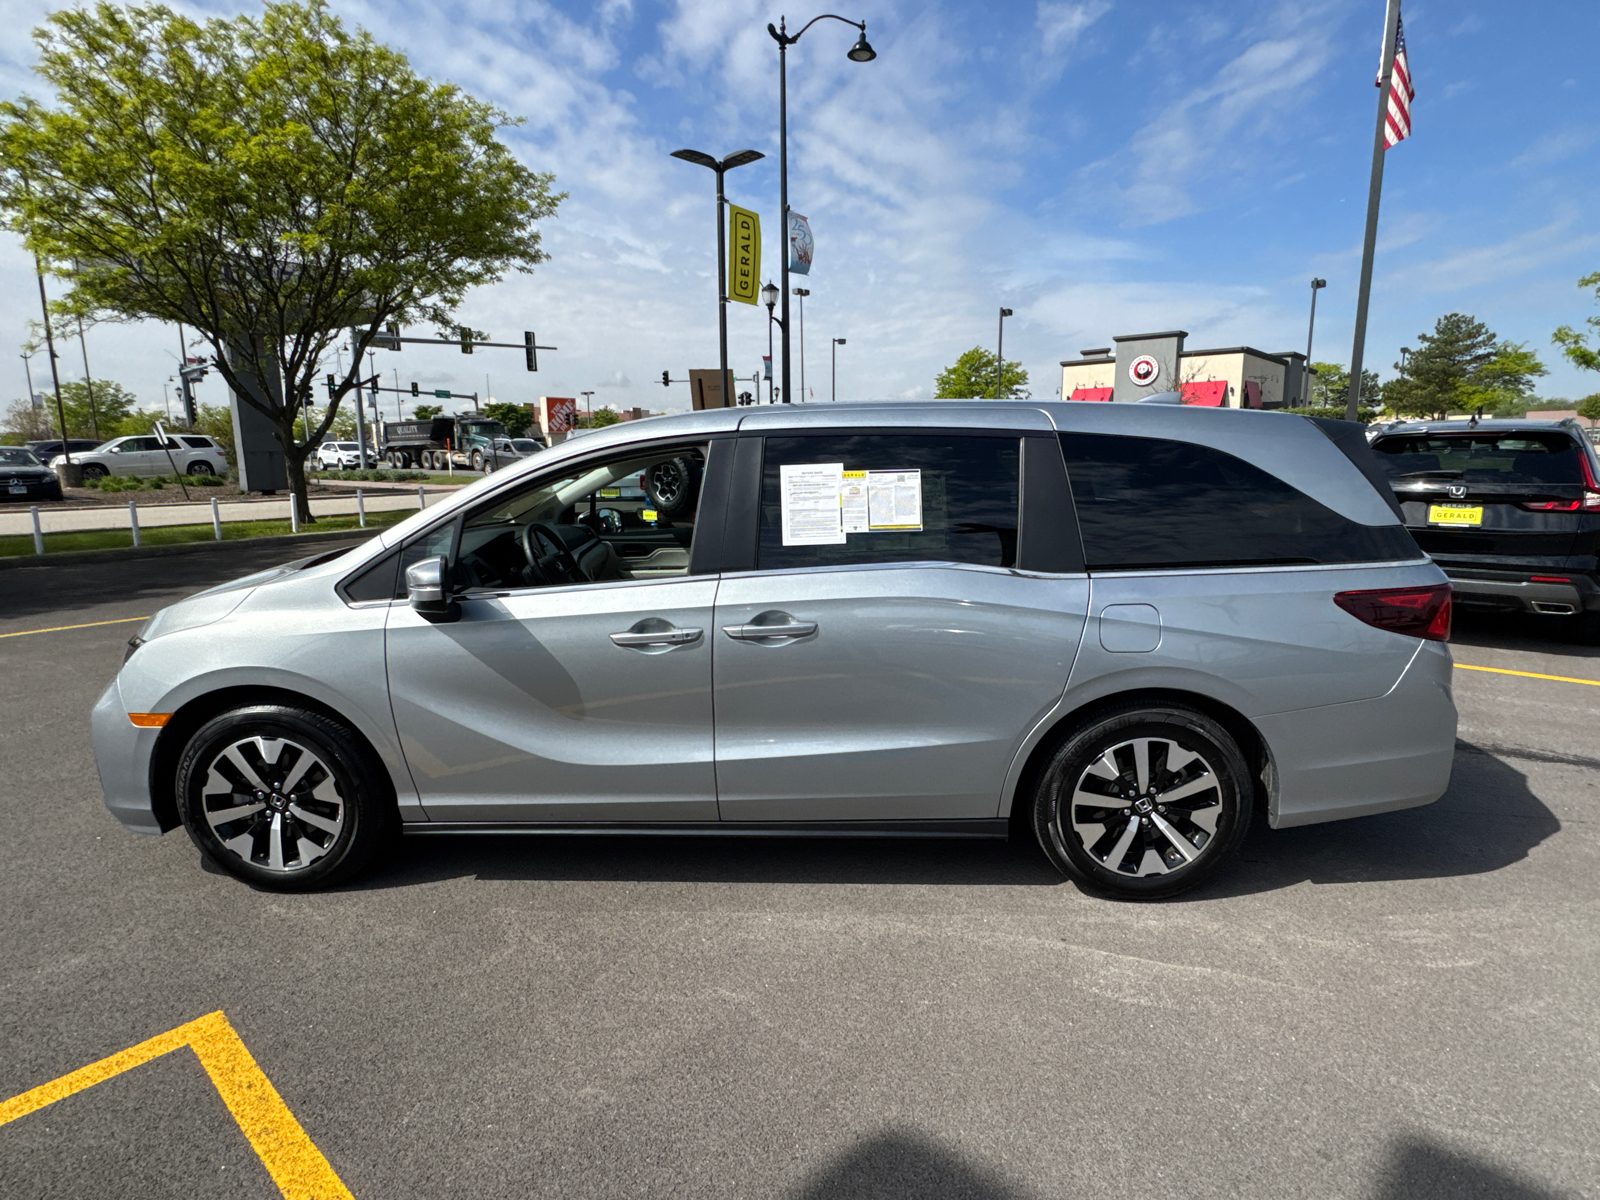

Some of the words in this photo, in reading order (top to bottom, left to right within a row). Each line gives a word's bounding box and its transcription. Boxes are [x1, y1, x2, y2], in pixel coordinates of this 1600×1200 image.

[790, 216, 812, 245] 250
[740, 220, 750, 290] GERALD
[549, 399, 575, 431] HOME
[550, 401, 562, 415] THE
[396, 425, 418, 435] QUALITY
[177, 741, 201, 812] TURANZA
